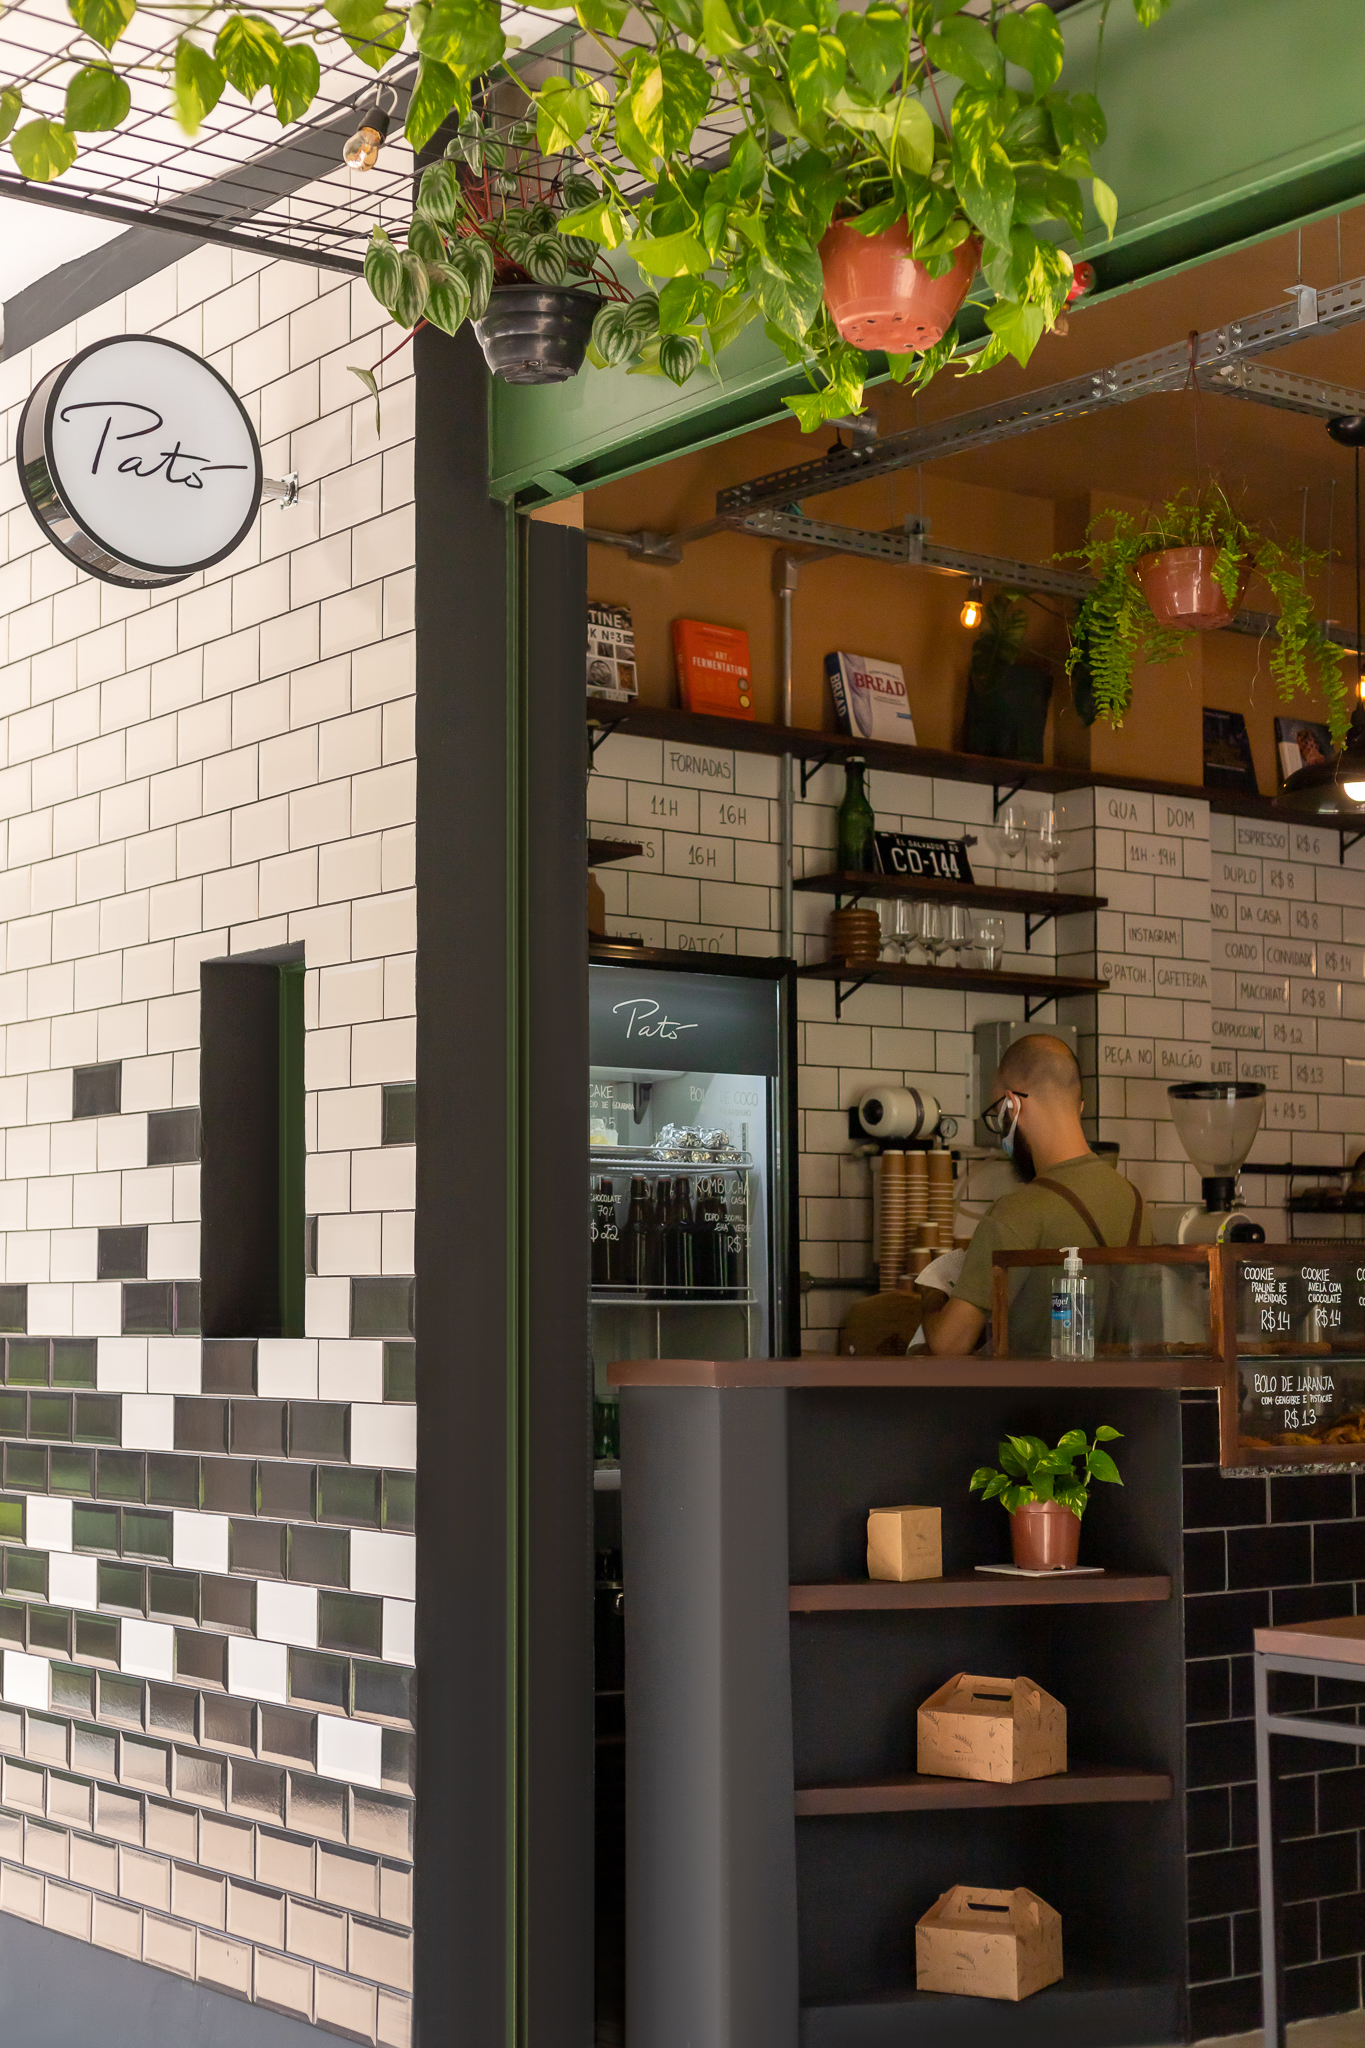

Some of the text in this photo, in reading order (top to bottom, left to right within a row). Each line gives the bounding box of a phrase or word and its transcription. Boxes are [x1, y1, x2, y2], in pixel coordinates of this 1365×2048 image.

[587, 609, 622, 628] TINE
[715, 650, 728, 661] ART
[692, 656, 748, 676] FERMENTATION
[829, 672, 847, 717] BREAD
[853, 672, 906, 697] BREAD
[669, 751, 732, 779] FORNADAS
[1108, 799, 1195, 829] QUA DOM
[896, 838, 906, 847] EL
[907, 840, 946, 851] SALVADOR
[1237, 828, 1286, 849] ESPRESSO
[891, 847, 961, 879] CD-144
[1223, 864, 1257, 884] DUPLO
[1240, 905, 1253, 921] DA
[1256, 907, 1282, 925] CASA
[1225, 942, 1258, 960] COADO
[1157, 969, 1208, 989] CAFETERIA
[1211, 1020, 1263, 1041] CAPPUCCINO
[1104, 1045, 1203, 1069] PEÇA NO BALCÃO
[1241, 1062, 1280, 1080] QUENTE
[695, 1175, 750, 1196] KOMBUCHA
[1243, 1266, 1275, 1281] COOKIE
[1301, 1266, 1330, 1282] COOKIE
[1278, 1282, 1287, 1293] DE
[1328, 1282, 1342, 1293] COM
[1307, 1293, 1342, 1304] CHOCOLATE
[1254, 1373, 1335, 1393] BOLO DE LARANJA
[1261, 1395, 1273, 1405] COM
[1302, 1394, 1308, 1404] E
